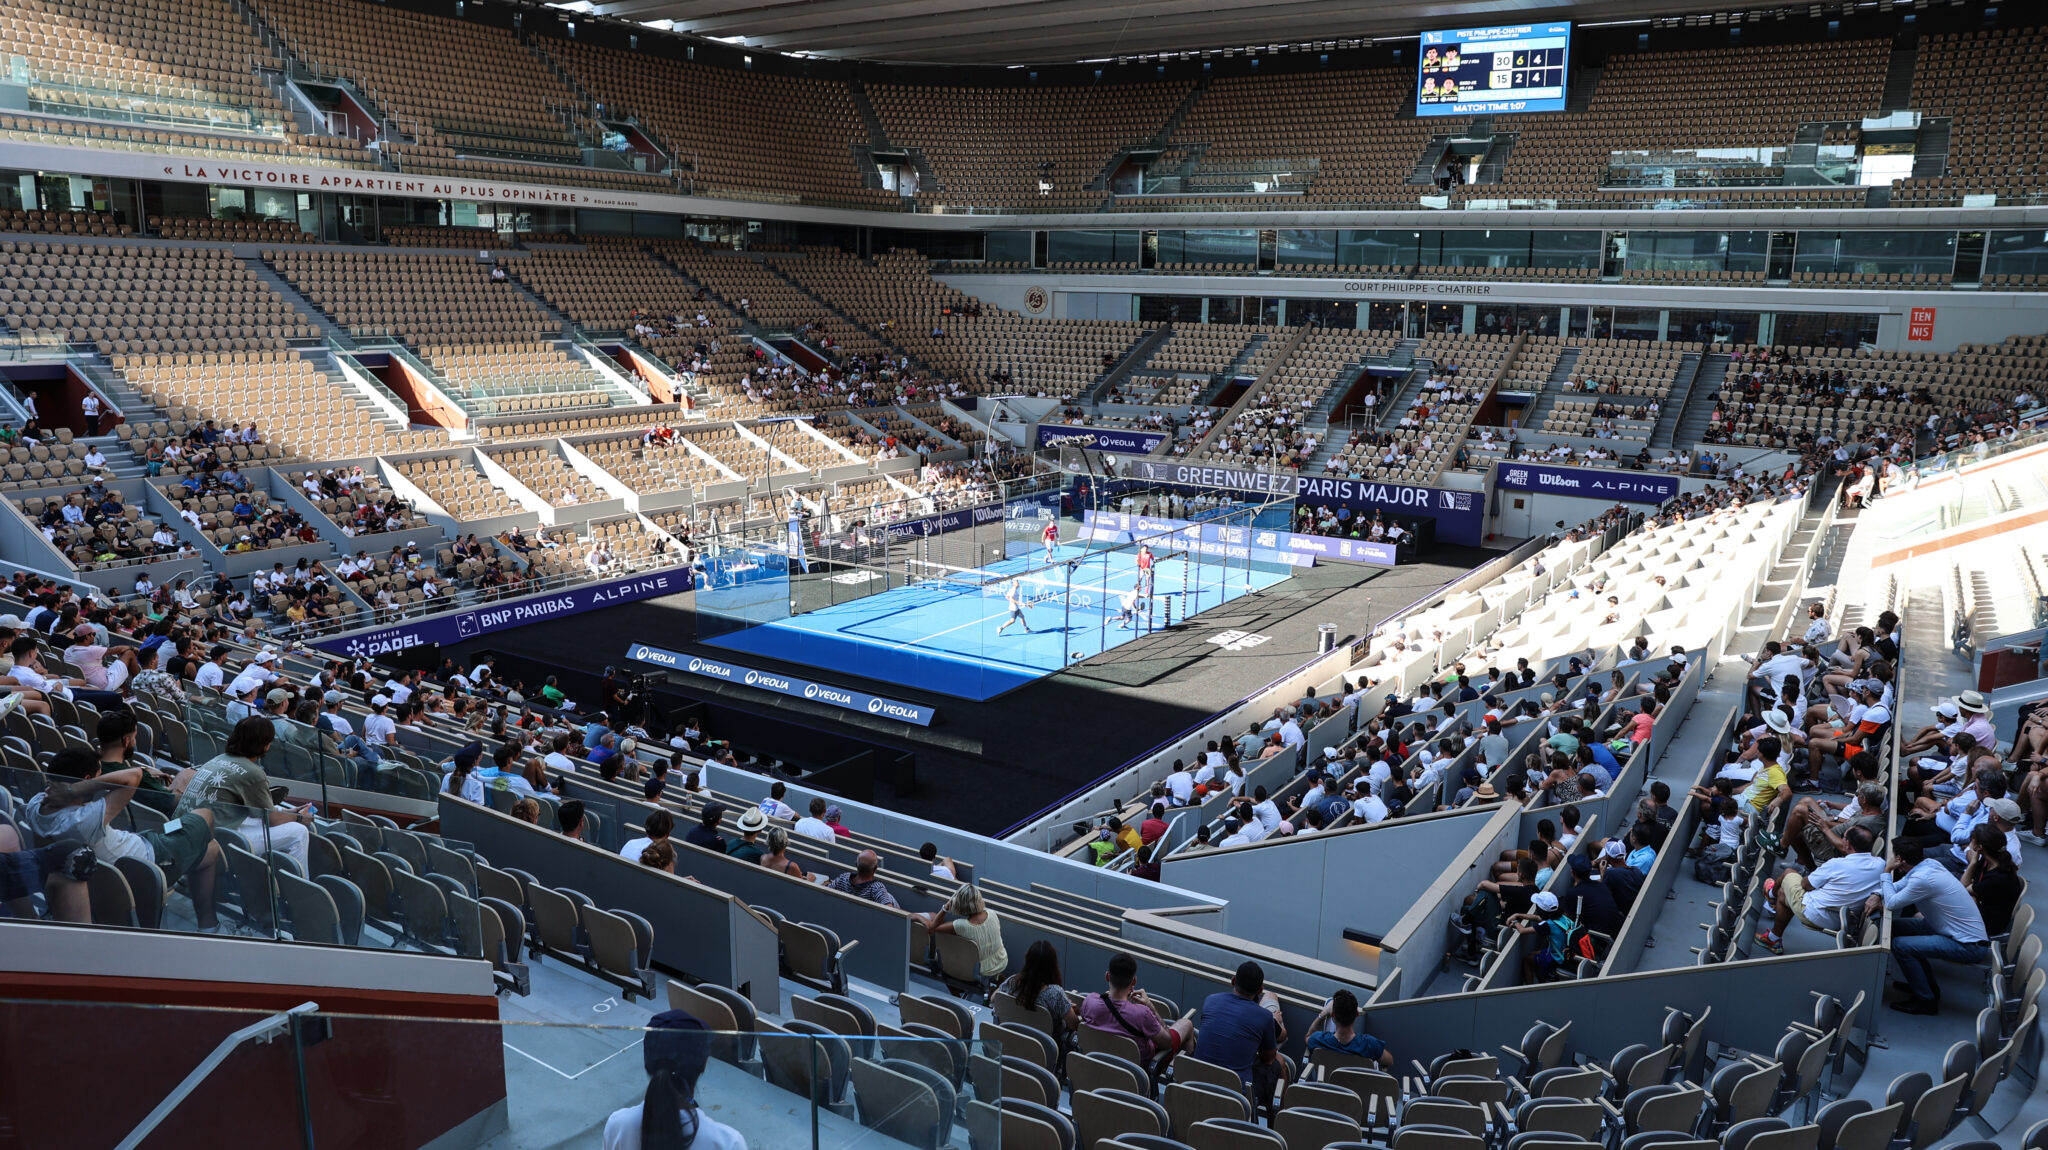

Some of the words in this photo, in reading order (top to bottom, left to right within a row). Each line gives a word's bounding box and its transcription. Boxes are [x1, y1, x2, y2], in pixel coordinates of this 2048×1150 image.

[1496, 57, 1510, 66] 30
[1516, 55, 1524, 66] 6
[1533, 54, 1542, 65] 4
[1497, 74, 1508, 83] 15
[1515, 73, 1523, 84] 2
[1532, 72, 1541, 83] 4
[1453, 103, 1486, 112] MATCH
[1487, 102, 1509, 111] TIME
[1510, 101, 1526, 110] 1:07
[184, 165, 207, 178] LA
[218, 168, 311, 185] VICTOIRE
[321, 176, 425, 192] APPARTIENT
[433, 183, 452, 195] AU
[461, 186, 494, 198] PLUS
[502, 188, 576, 203] OPINIÂTRE
[1344, 282, 1380, 292] COURT
[1382, 283, 1428, 293] PHILIPPE
[1437, 284, 1491, 294] CHATRIER
[1913, 311, 1932, 322] TEN
[1911, 327, 1929, 337] NIS
[1109, 439, 1136, 447] VEOLIA
[1509, 468, 1529, 478] GREEN
[1177, 466, 1291, 493] GREENWEEZ
[1297, 477, 1352, 499] PARIS
[1359, 483, 1429, 507] MAJOR
[1511, 477, 1528, 486] WEEZ
[1538, 473, 1580, 488] Wilson
[1591, 480, 1669, 495] ALPINE
[975, 507, 1003, 521] Wilson
[592, 577, 669, 603] ALPINE
[480, 609, 511, 627] BNP
[514, 596, 575, 620] PARIBAS
[367, 629, 400, 641] PREMIER
[368, 633, 424, 656] PADEL
[647, 651, 676, 665] VEOLIA
[701, 663, 731, 677] VEOLIA
[758, 675, 789, 691] VEOLIA
[817, 688, 851, 704] VEOLIA
[881, 703, 919, 720] VEOLIA
